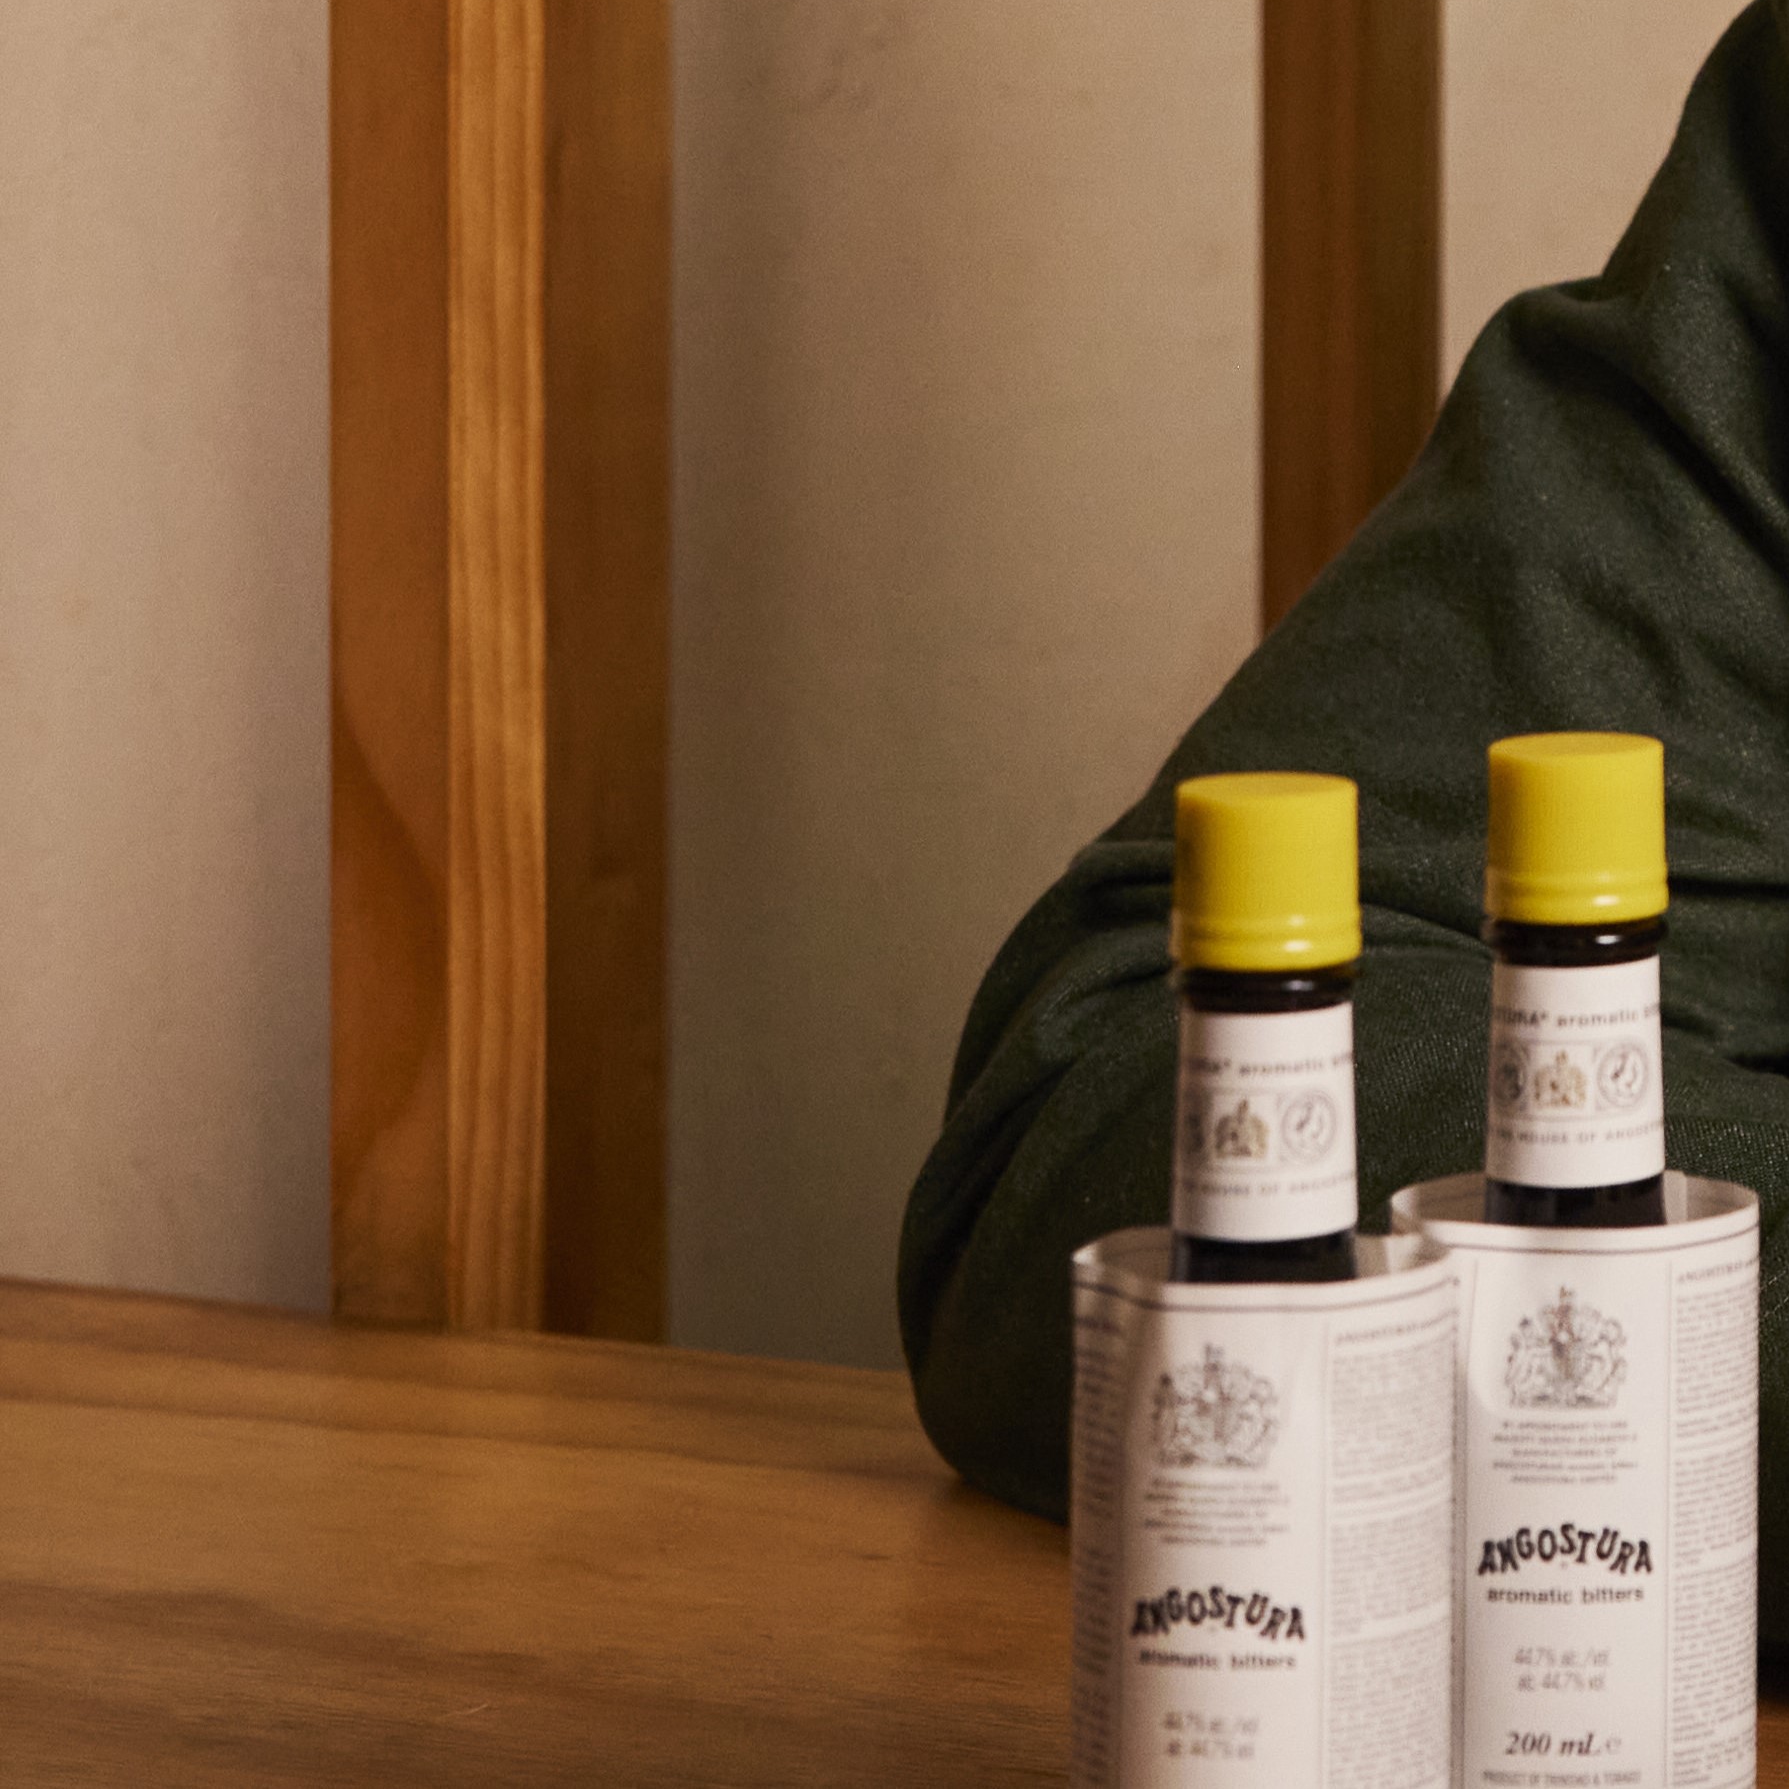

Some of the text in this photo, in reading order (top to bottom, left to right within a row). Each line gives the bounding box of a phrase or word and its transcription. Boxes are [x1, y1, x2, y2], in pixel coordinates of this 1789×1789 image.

[1478, 1522, 1653, 1576] ANGOSTURA
[1130, 1585, 1306, 1641] ANGOSTURA
[1487, 1585, 1645, 1605] aromatic bitters
[1504, 1730, 1552, 1756] 200
